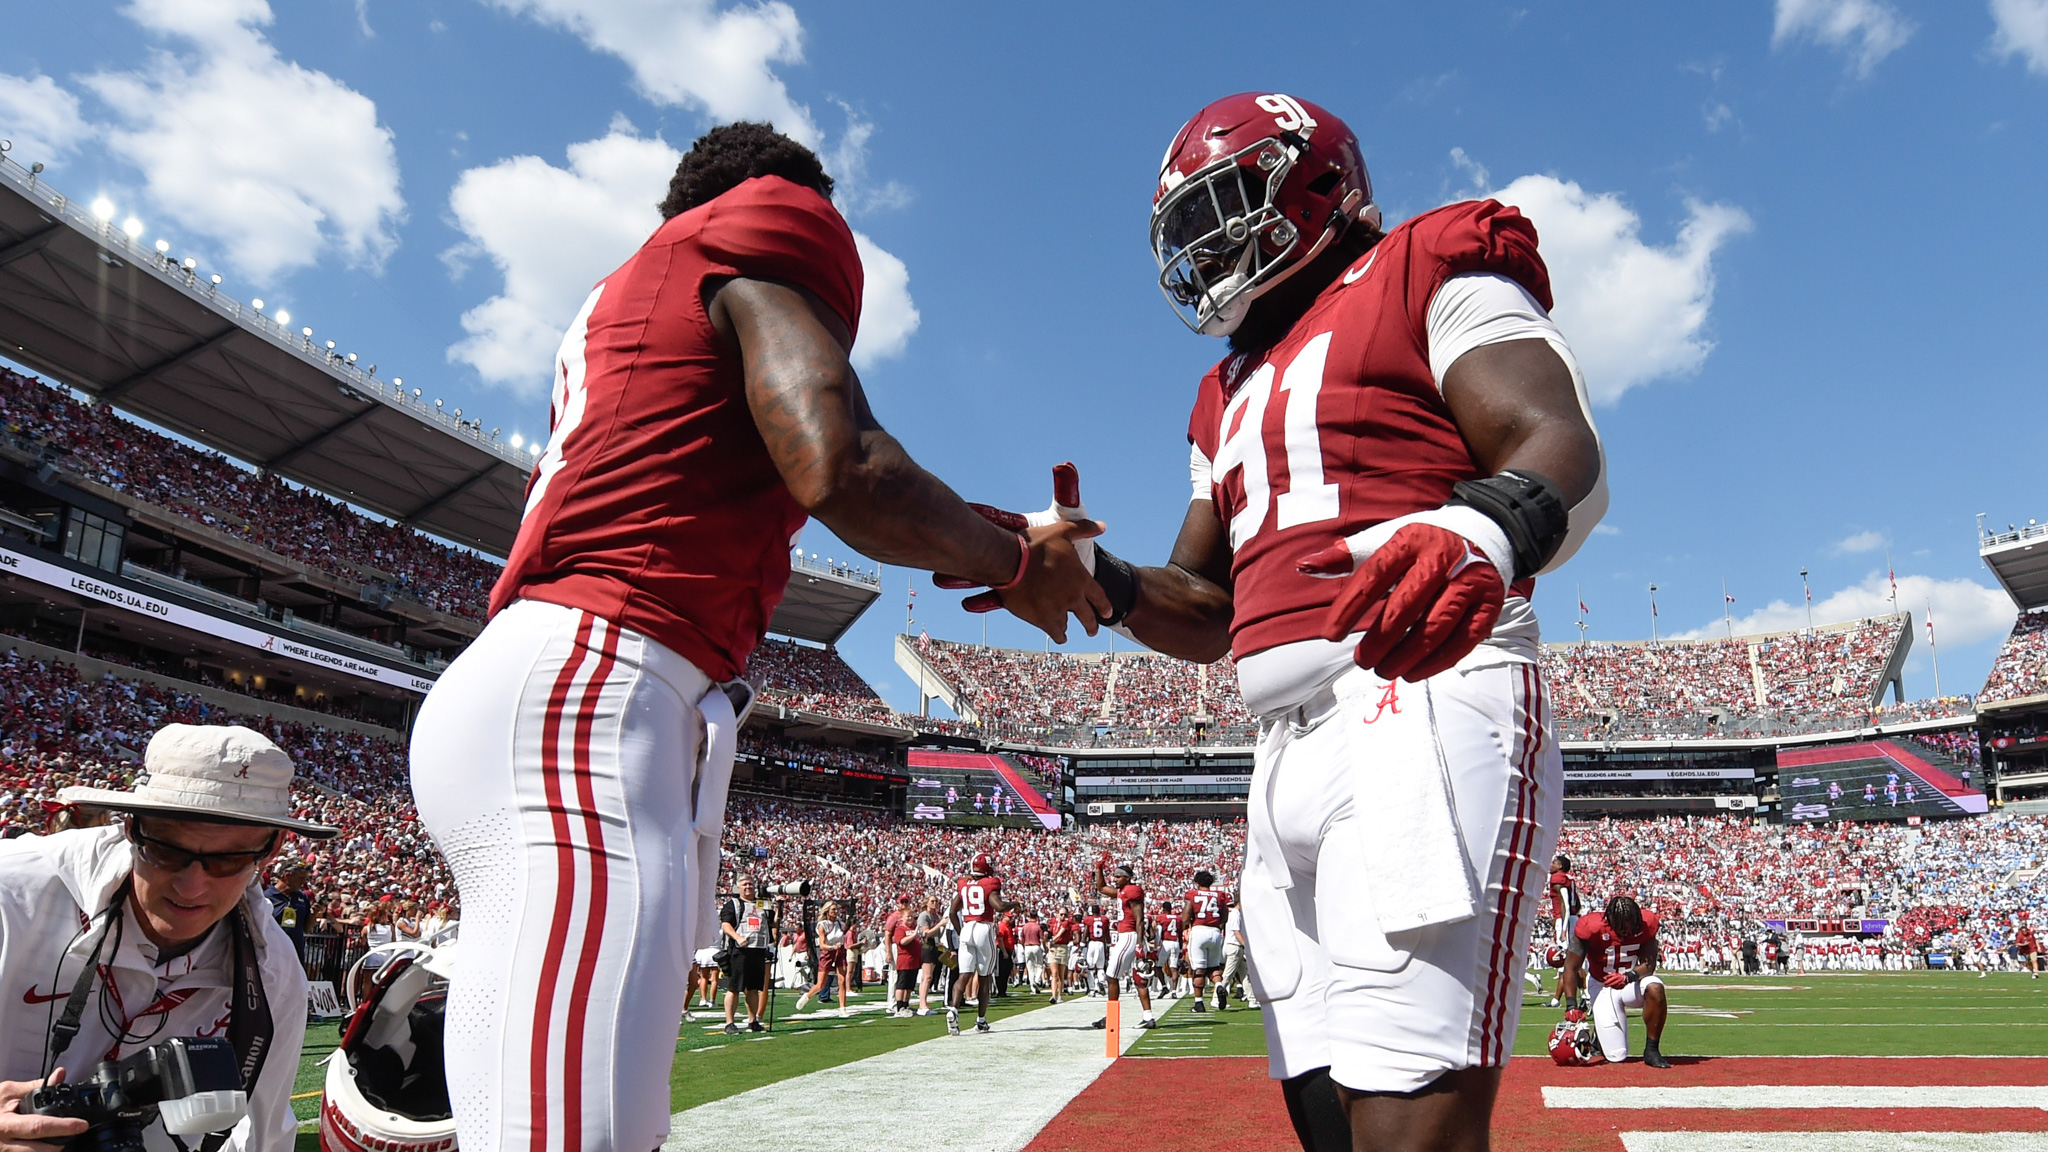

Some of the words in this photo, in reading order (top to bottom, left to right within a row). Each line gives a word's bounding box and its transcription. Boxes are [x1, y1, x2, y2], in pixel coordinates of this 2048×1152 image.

[1255, 94, 1318, 131] 91
[1211, 330, 1340, 555] 91
[71, 577, 168, 616] LEGENDS.UA.EDU
[282, 643, 309, 658] WHERE
[310, 651, 343, 667] LEGENDS
[344, 660, 357, 671] ARE
[358, 665, 378, 677] MADE
[961, 886, 985, 916] 19
[1194, 895, 1220, 918] 74
[1093, 921, 1103, 938] 6
[1167, 919, 1178, 936] 4
[1846, 920, 1858, 930] 25
[1864, 923, 1885, 931] xfinity
[1603, 944, 1640, 974] 15
[245, 966, 258, 1011] CPS
